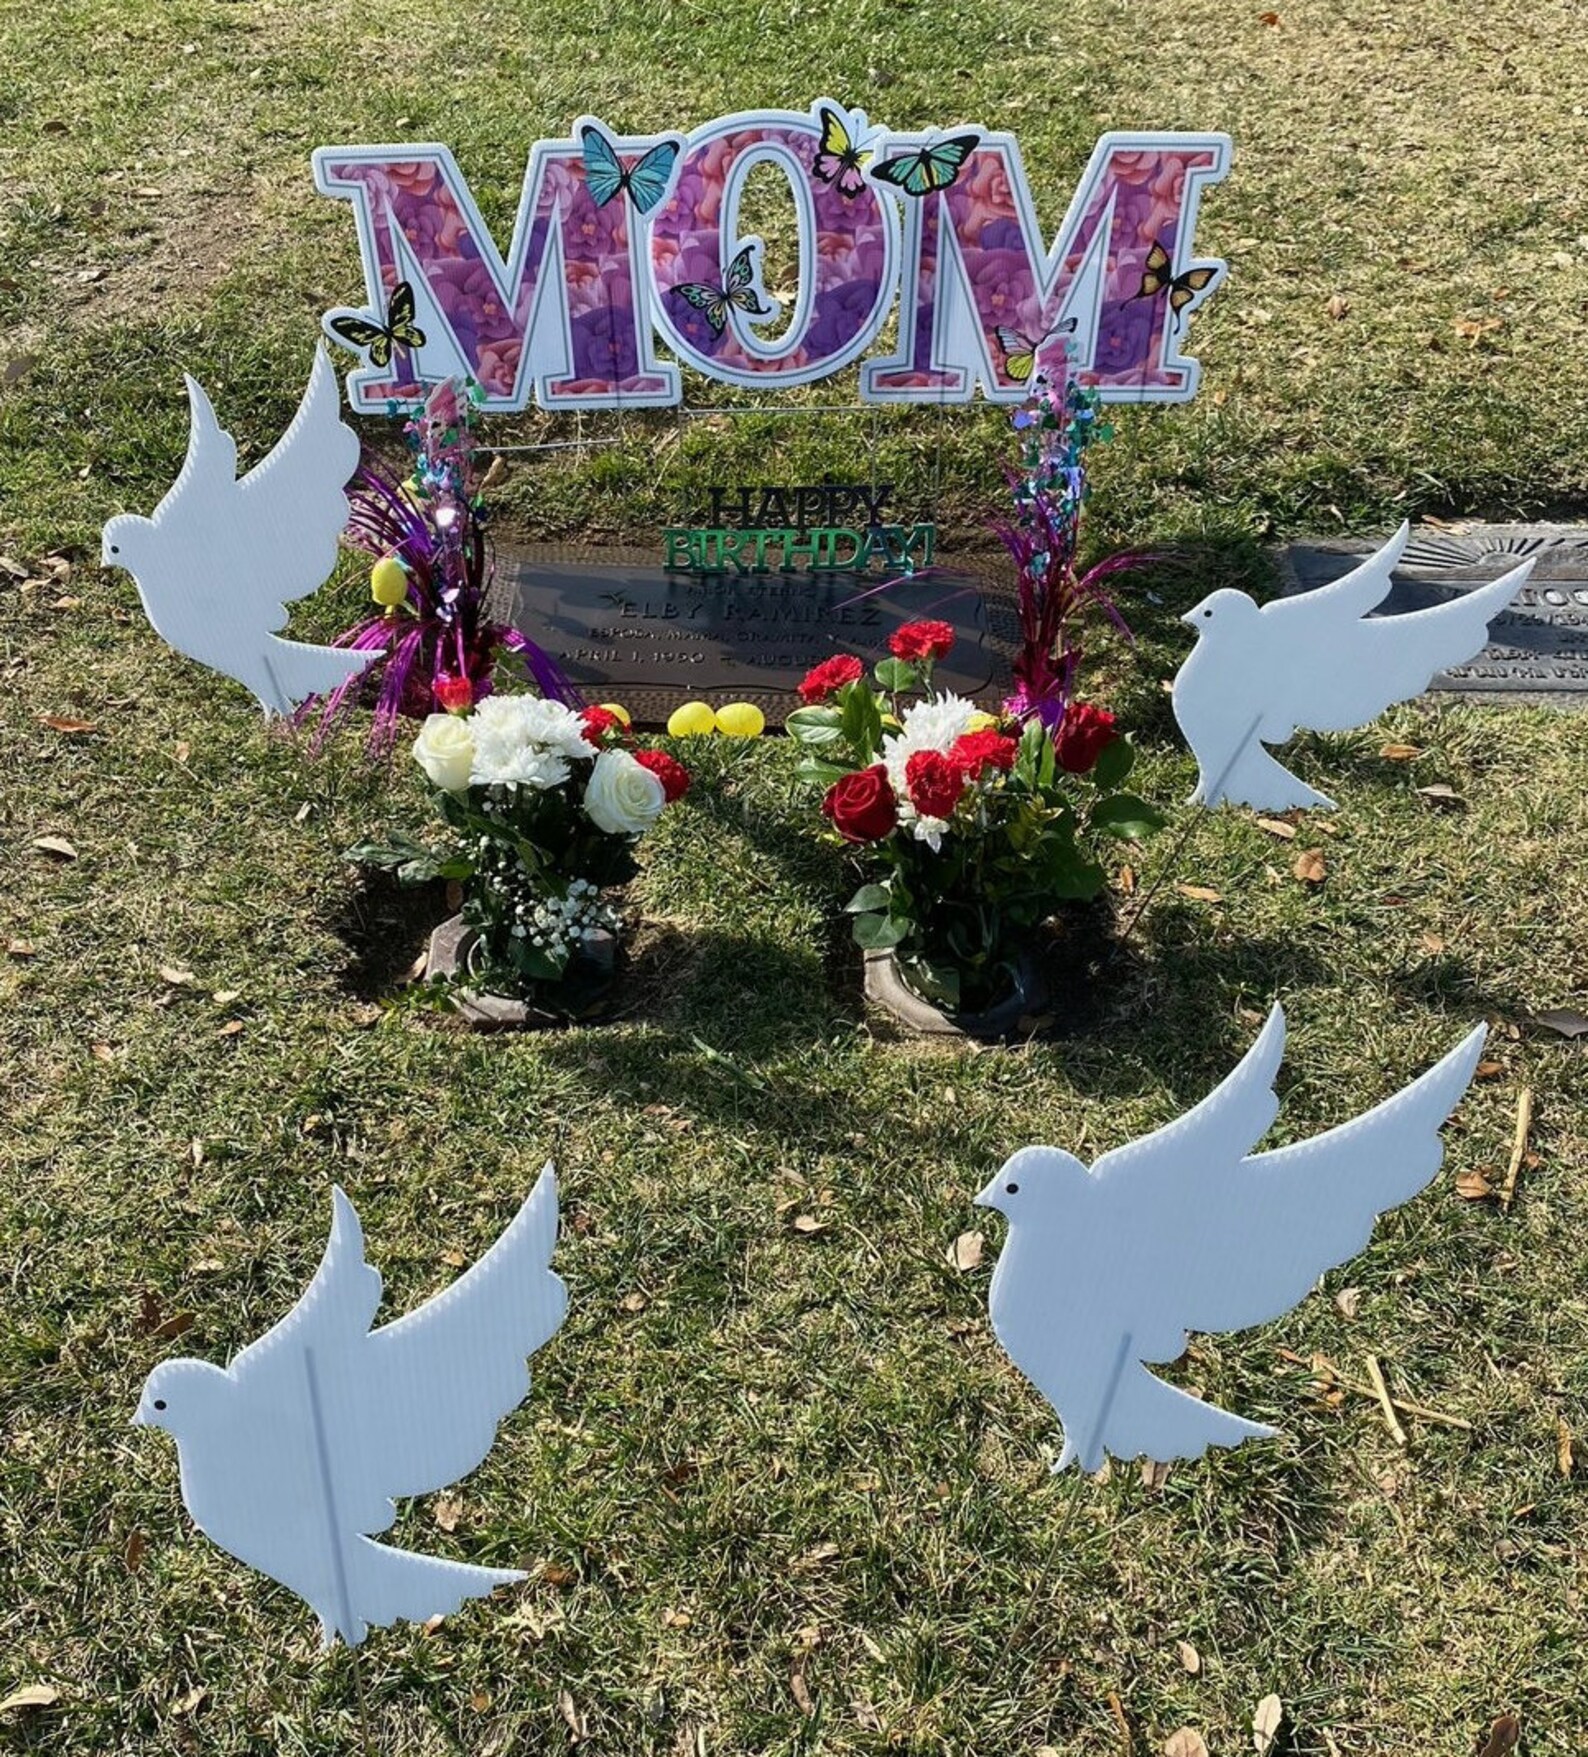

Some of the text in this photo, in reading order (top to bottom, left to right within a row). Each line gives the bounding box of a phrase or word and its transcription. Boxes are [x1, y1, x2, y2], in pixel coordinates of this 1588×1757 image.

[316, 112, 1230, 410] MOM
[708, 485, 894, 528] HAPPY
[663, 523, 936, 573] BIRTHDAY!
[619, 601, 882, 625] ELBY RAMIREZ
[558, 649, 623, 662] APRIL
[652, 652, 706, 664] 1950
